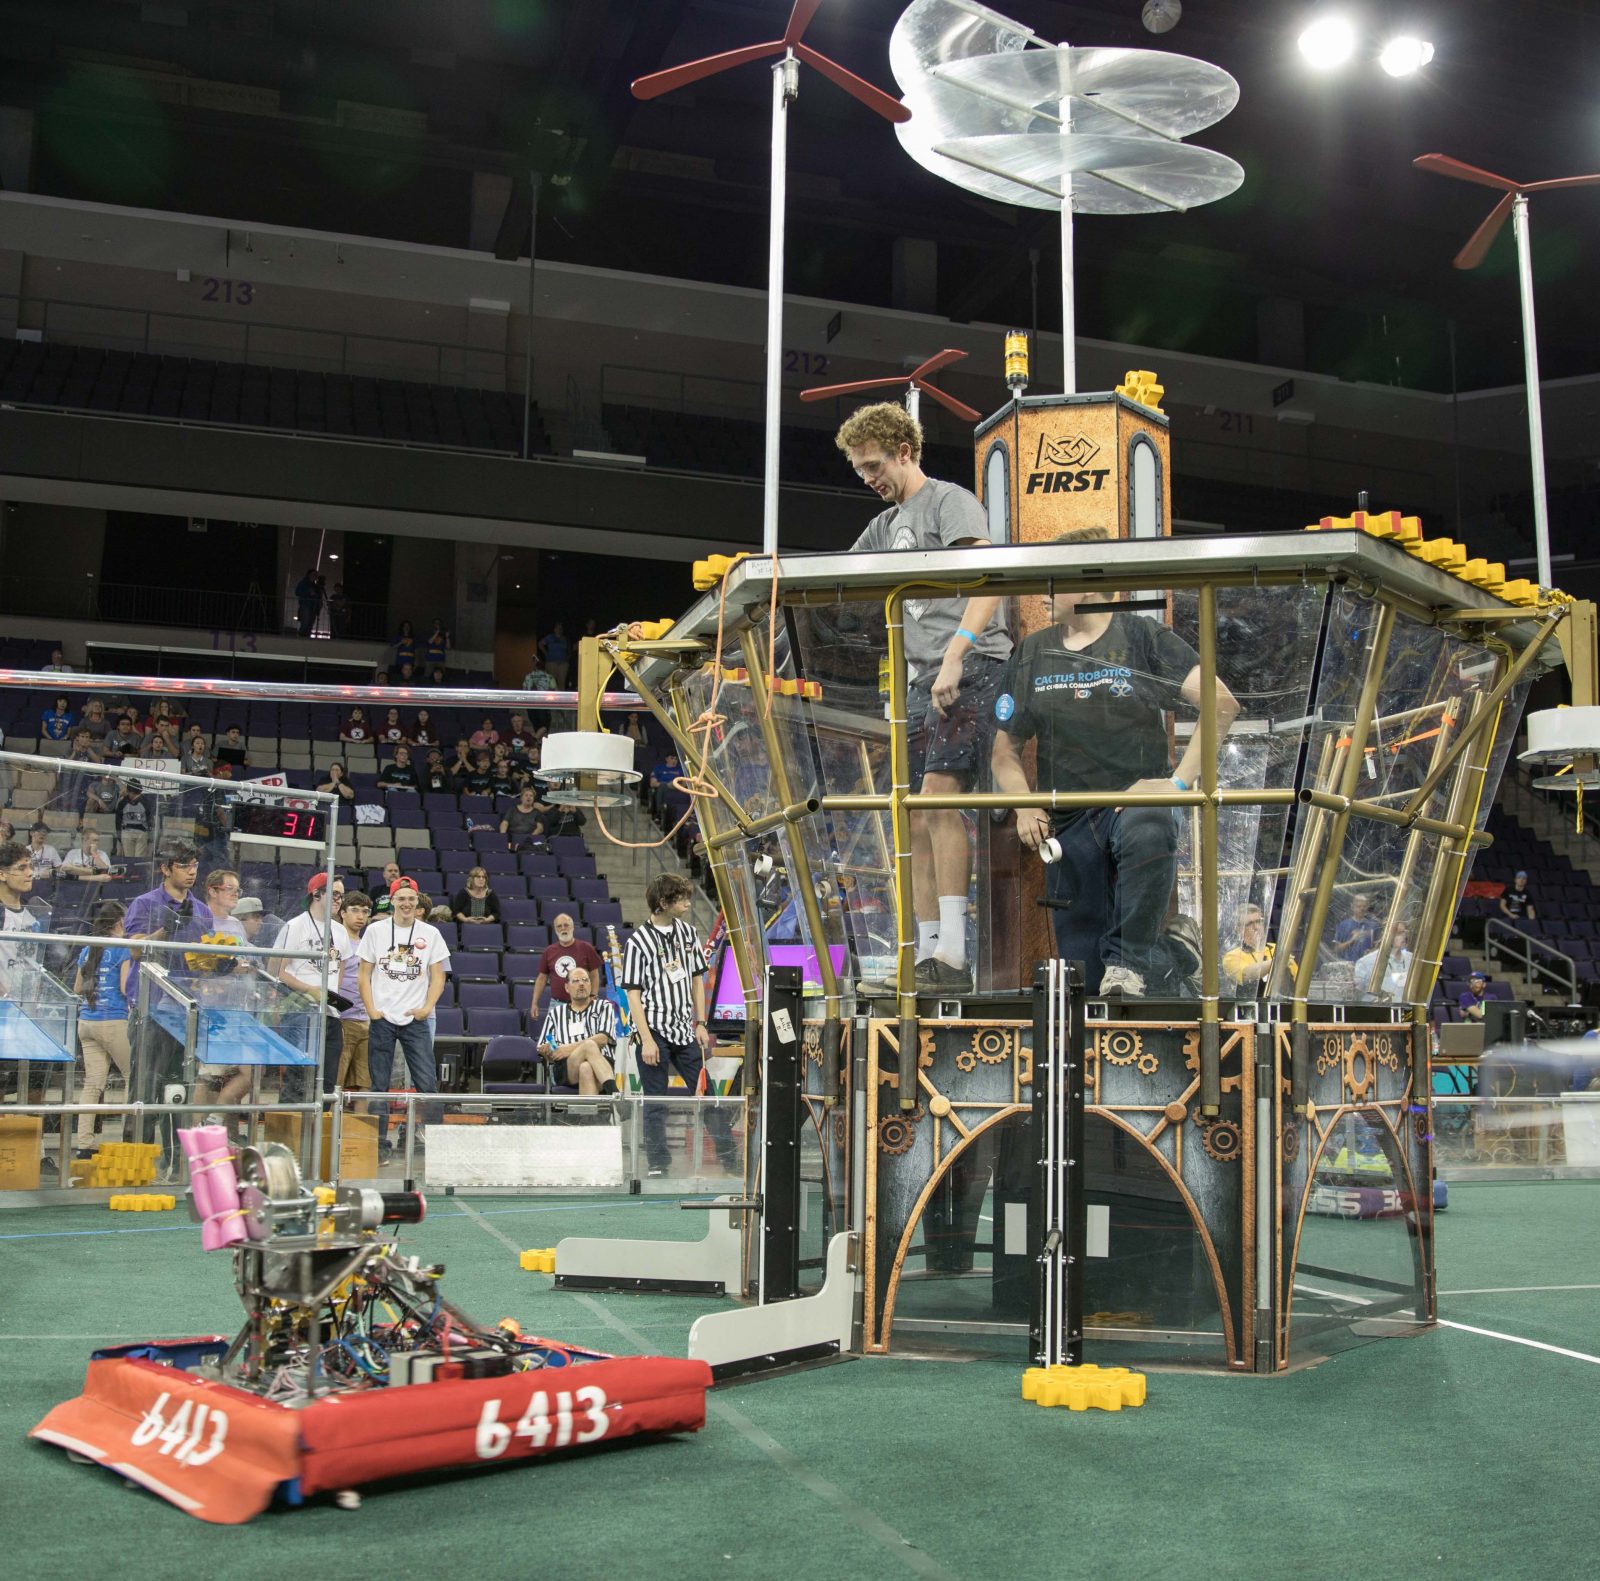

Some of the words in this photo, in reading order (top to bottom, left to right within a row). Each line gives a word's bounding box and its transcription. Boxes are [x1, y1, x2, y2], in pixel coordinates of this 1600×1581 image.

[201, 278, 253, 306] 213
[784, 350, 827, 375] 212
[1220, 411, 1253, 434] 211
[1026, 468, 1110, 494] FIRST
[210, 629, 257, 653] 113
[1034, 673, 1075, 686] CACTUS
[1077, 667, 1132, 682] ROBOTICS
[1034, 685, 1046, 693] THE
[1068, 677, 1113, 689] COMMANDERS
[283, 813, 315, 838] 31
[131, 1392, 229, 1467] 6413
[475, 1385, 609, 1460] 6413
